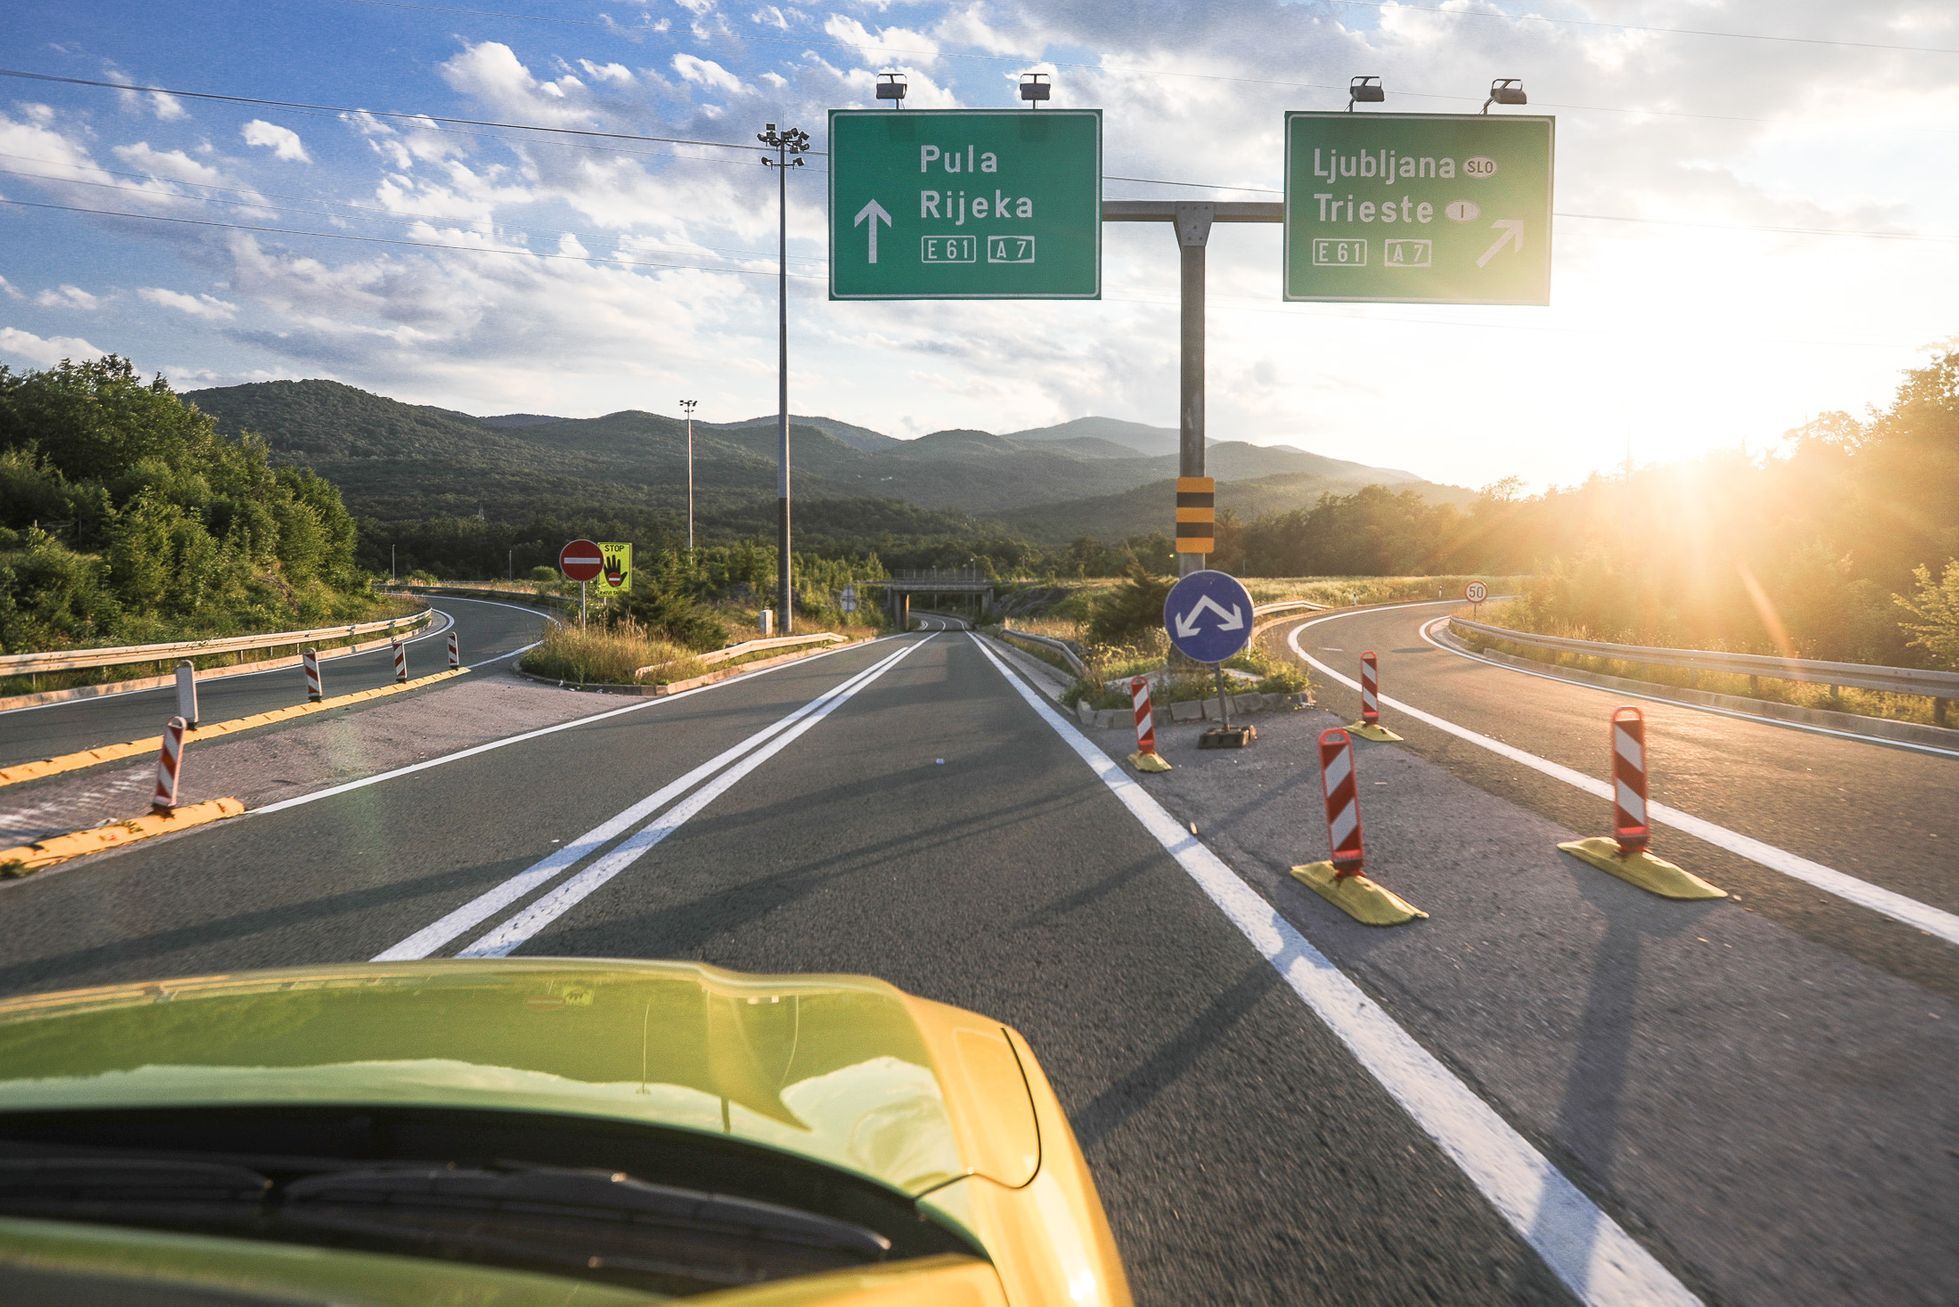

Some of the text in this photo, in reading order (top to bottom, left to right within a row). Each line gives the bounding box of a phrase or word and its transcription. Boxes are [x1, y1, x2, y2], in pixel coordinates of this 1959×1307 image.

[920, 144, 998, 173] Pula
[1313, 148, 1494, 185] Ljubljana SLO
[920, 189, 1033, 226] Rijeka
[1313, 193, 1434, 223] Trieste
[604, 544, 625, 552] STOP
[1468, 586, 1484, 598] 50
